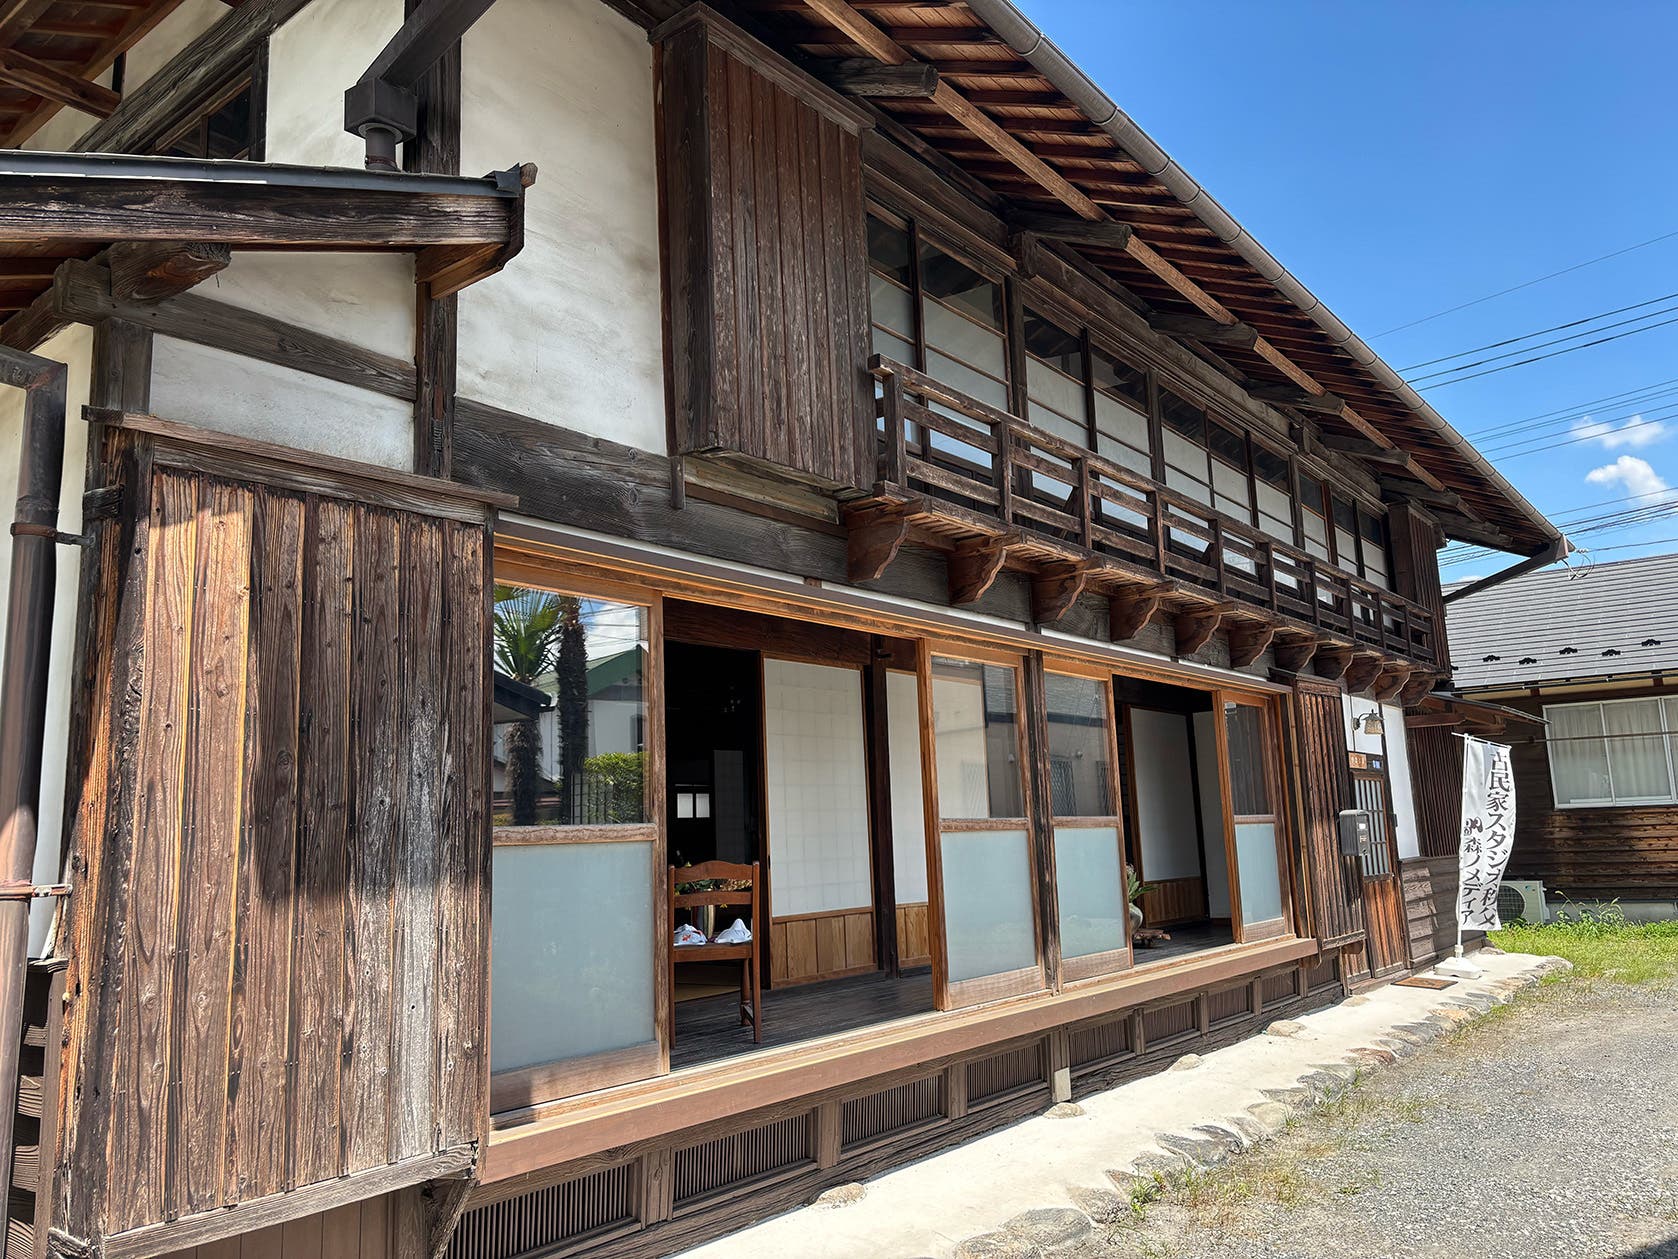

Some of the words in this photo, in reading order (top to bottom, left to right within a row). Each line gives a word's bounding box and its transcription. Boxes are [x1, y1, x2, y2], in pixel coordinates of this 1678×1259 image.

[1461, 837, 1484, 925] 森ノメディア
